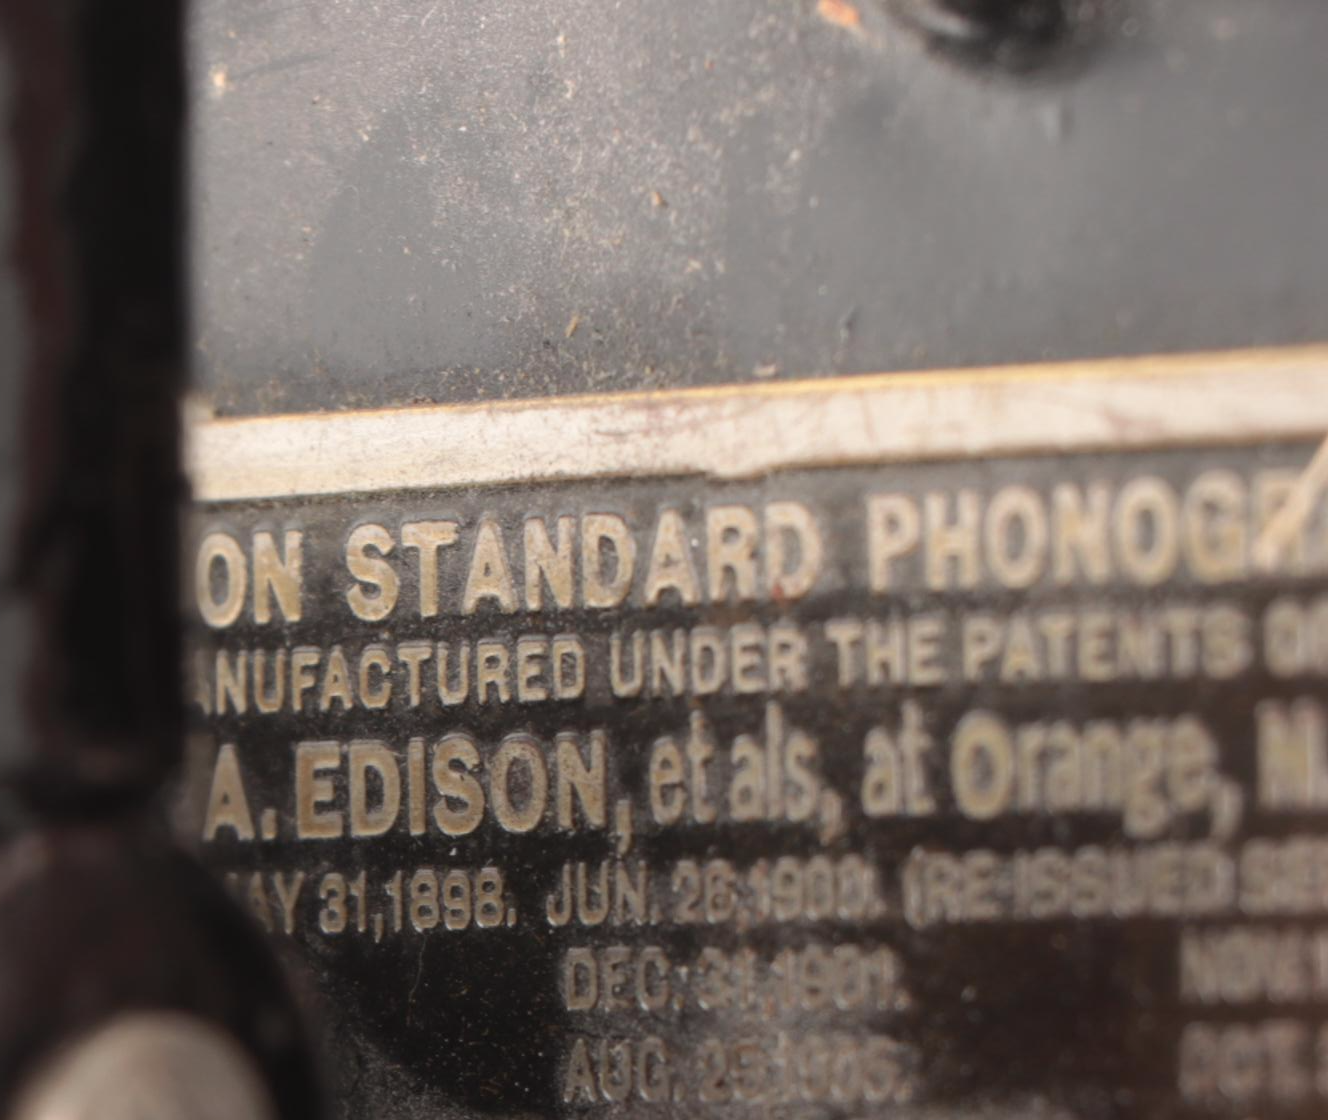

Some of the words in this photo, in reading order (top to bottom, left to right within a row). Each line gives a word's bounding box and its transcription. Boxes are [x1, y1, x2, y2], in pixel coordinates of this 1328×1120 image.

[196, 530, 304, 628] ON
[346, 502, 824, 622] STANDARD
[194, 634, 585, 716] NUFACTURED
[610, 622, 808, 700] UNDER
[825, 612, 944, 688] THE
[962, 603, 1252, 682] PATENTS
[202, 744, 278, 842] A.
[295, 730, 634, 856] EDISON,
[648, 708, 717, 826] et
[728, 702, 844, 846] als,
[862, 700, 936, 818] at
[950, 706, 1246, 838] Orange,
[226, 870, 304, 935] AY
[317, 864, 518, 944] 31,1898.
[546, 858, 662, 928] JUN.
